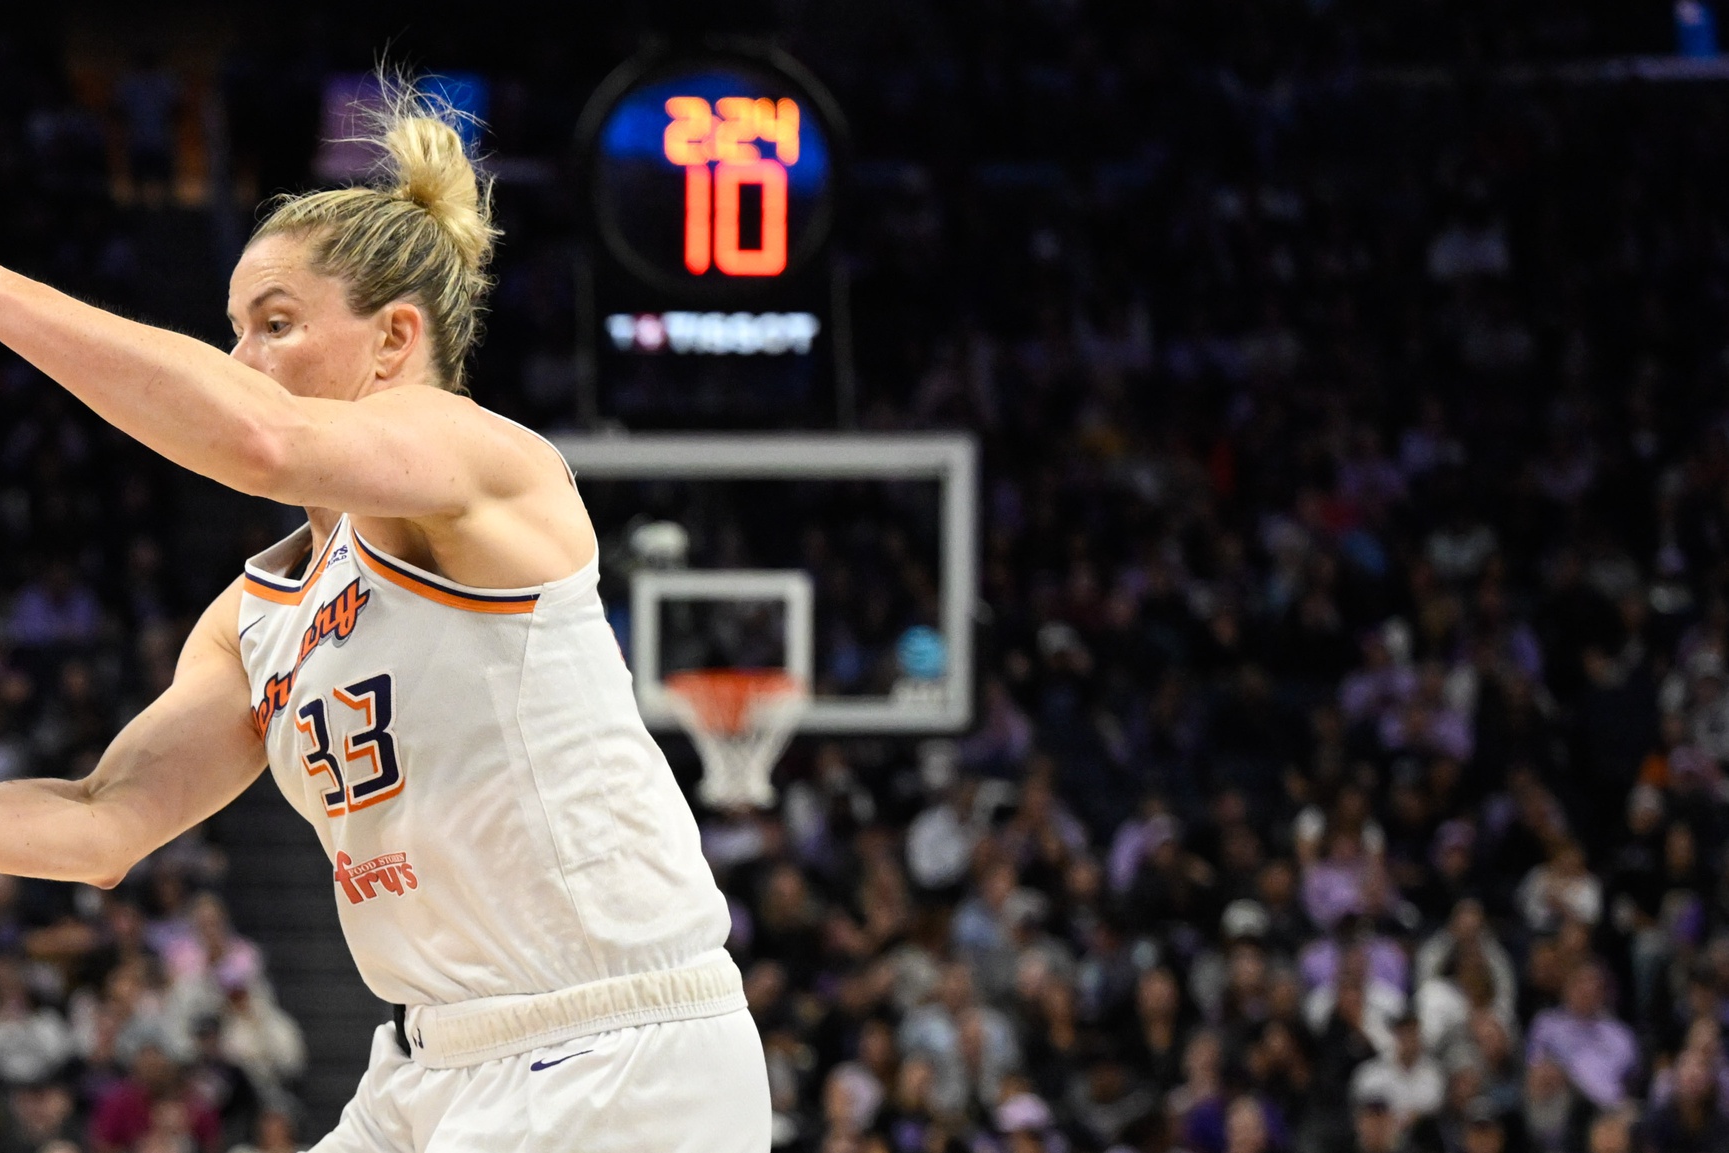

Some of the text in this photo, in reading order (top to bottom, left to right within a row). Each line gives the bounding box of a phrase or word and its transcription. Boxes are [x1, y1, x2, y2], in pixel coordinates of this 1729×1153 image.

[684, 158, 788, 277] 10
[293, 670, 405, 818] 33
[347, 860, 377, 878] FOOD
